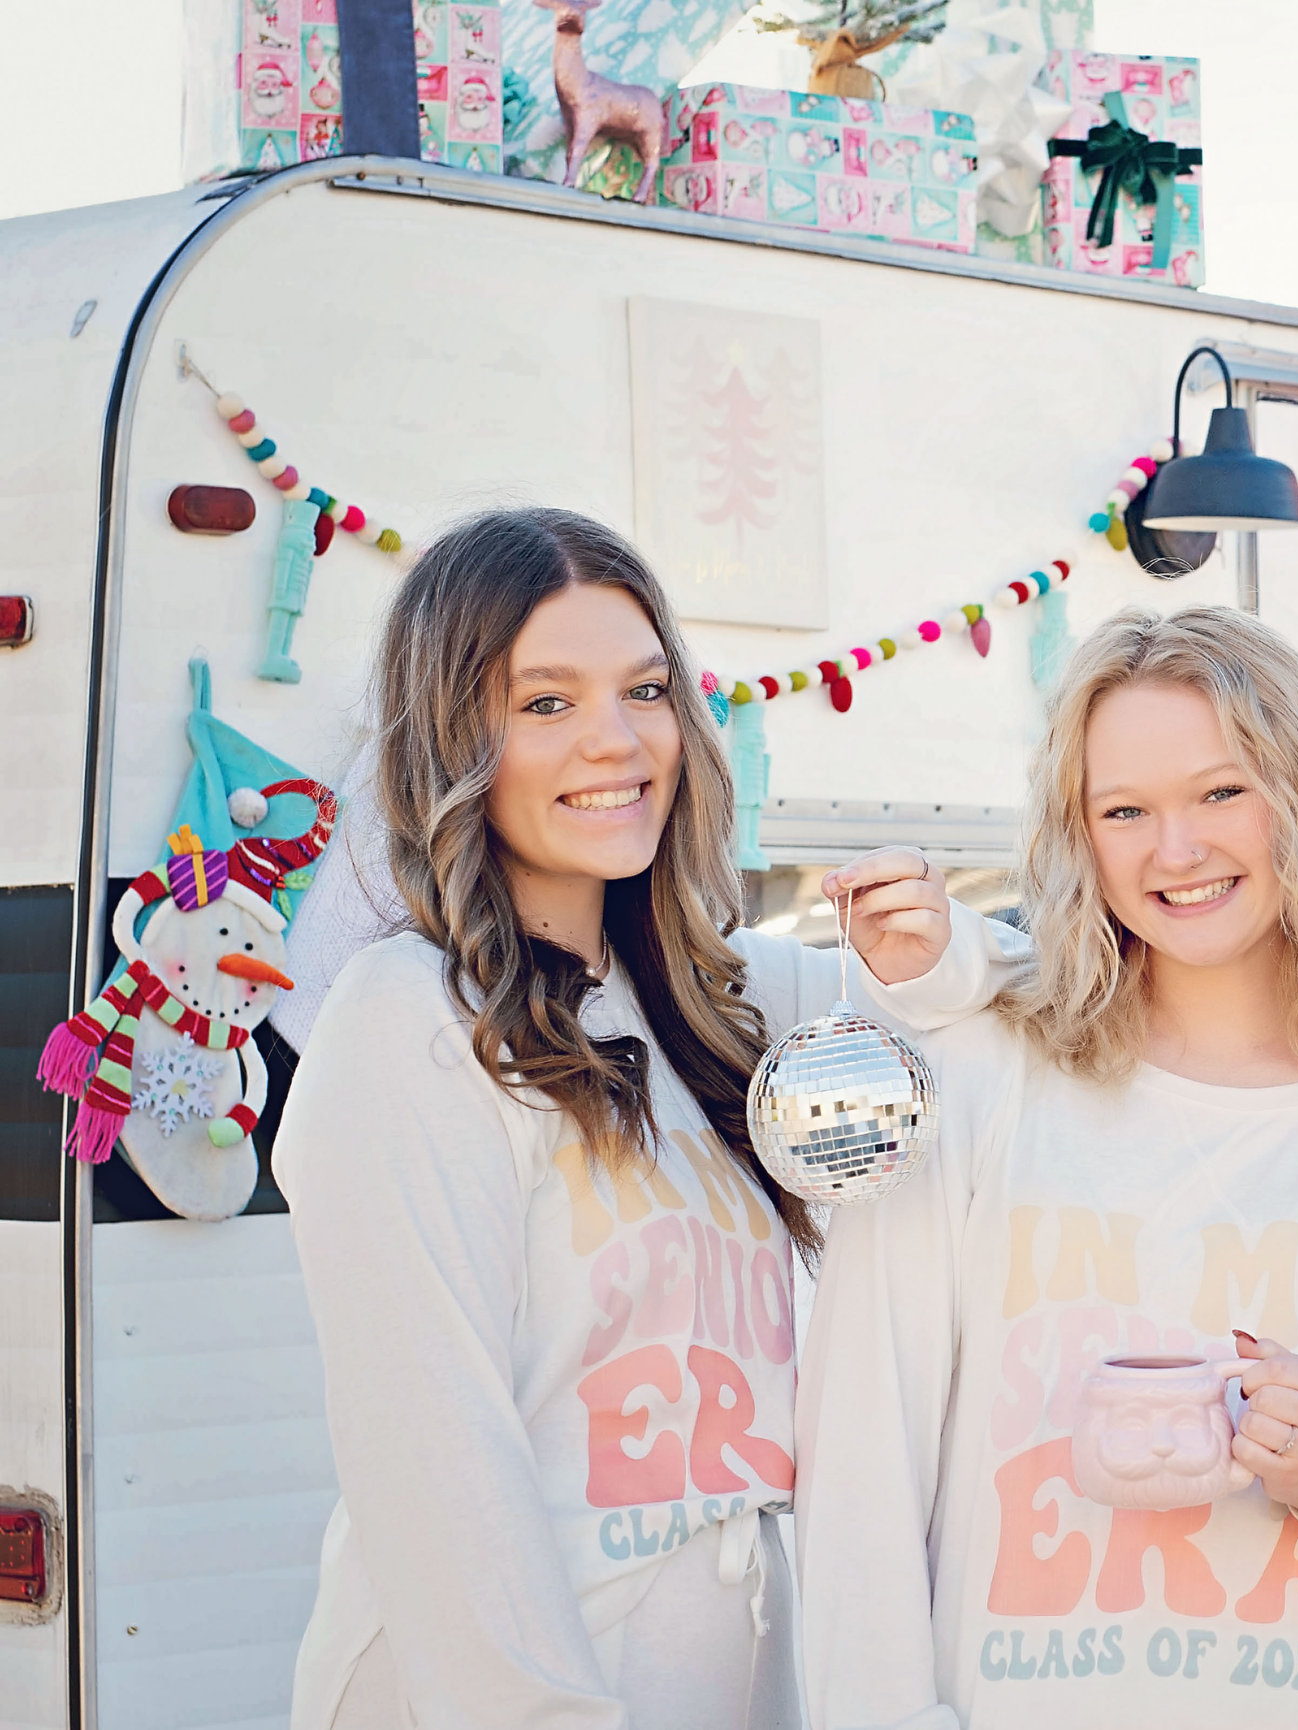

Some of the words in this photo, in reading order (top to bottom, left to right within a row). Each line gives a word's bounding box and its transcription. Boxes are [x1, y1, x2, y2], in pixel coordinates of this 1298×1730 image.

[582, 1214, 794, 1367] SENIO
[1002, 1205, 1143, 1320] IN
[577, 1344, 798, 1508] ER
[979, 1625, 1126, 1682] CLASS
[1146, 1627, 1217, 1680] OF
